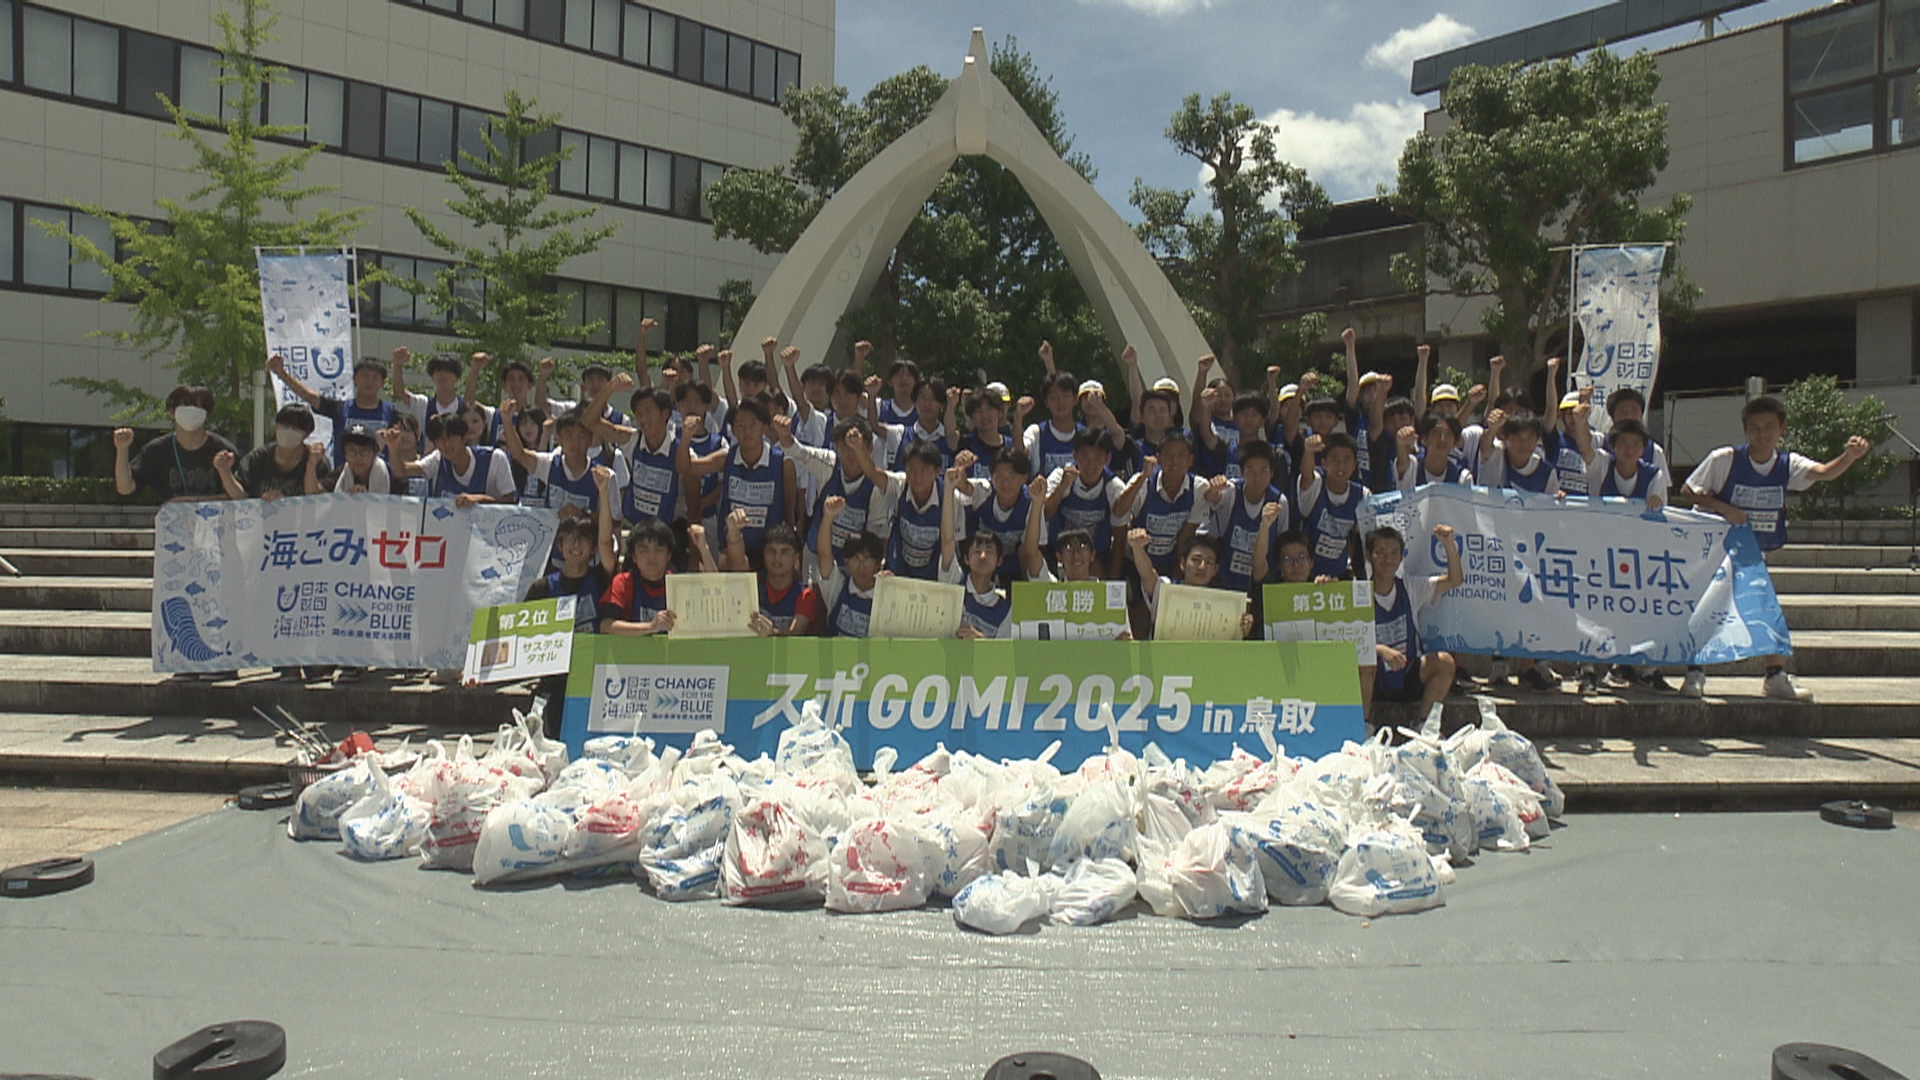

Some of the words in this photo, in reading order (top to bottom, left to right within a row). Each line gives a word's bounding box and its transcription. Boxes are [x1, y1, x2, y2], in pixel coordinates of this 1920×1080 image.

[1618, 342, 1653, 359] 日本
[260, 528, 447, 571] 海ごみゼロ
[1466, 533, 1504, 552] 日本
[1514, 532, 1690, 609] 海と日本
[302, 581, 328, 596] 日本
[334, 581, 416, 601] CHANGE
[1441, 587, 1507, 602] OUNDATION
[371, 602, 393, 612] FOR
[395, 603, 413, 612] THE
[1046, 589, 1094, 613] 優勝
[1293, 591, 1346, 613] 第3位
[1587, 594, 1696, 616] PROJECT
[370, 614, 412, 631] BLUE
[499, 608, 548, 630] 第2位
[654, 677, 716, 690] CHANGE
[680, 700, 714, 713] BLUE
[1033, 674, 1193, 732] 2025
[1202, 700, 1233, 733] in
[1239, 695, 1317, 735] 鳥取
